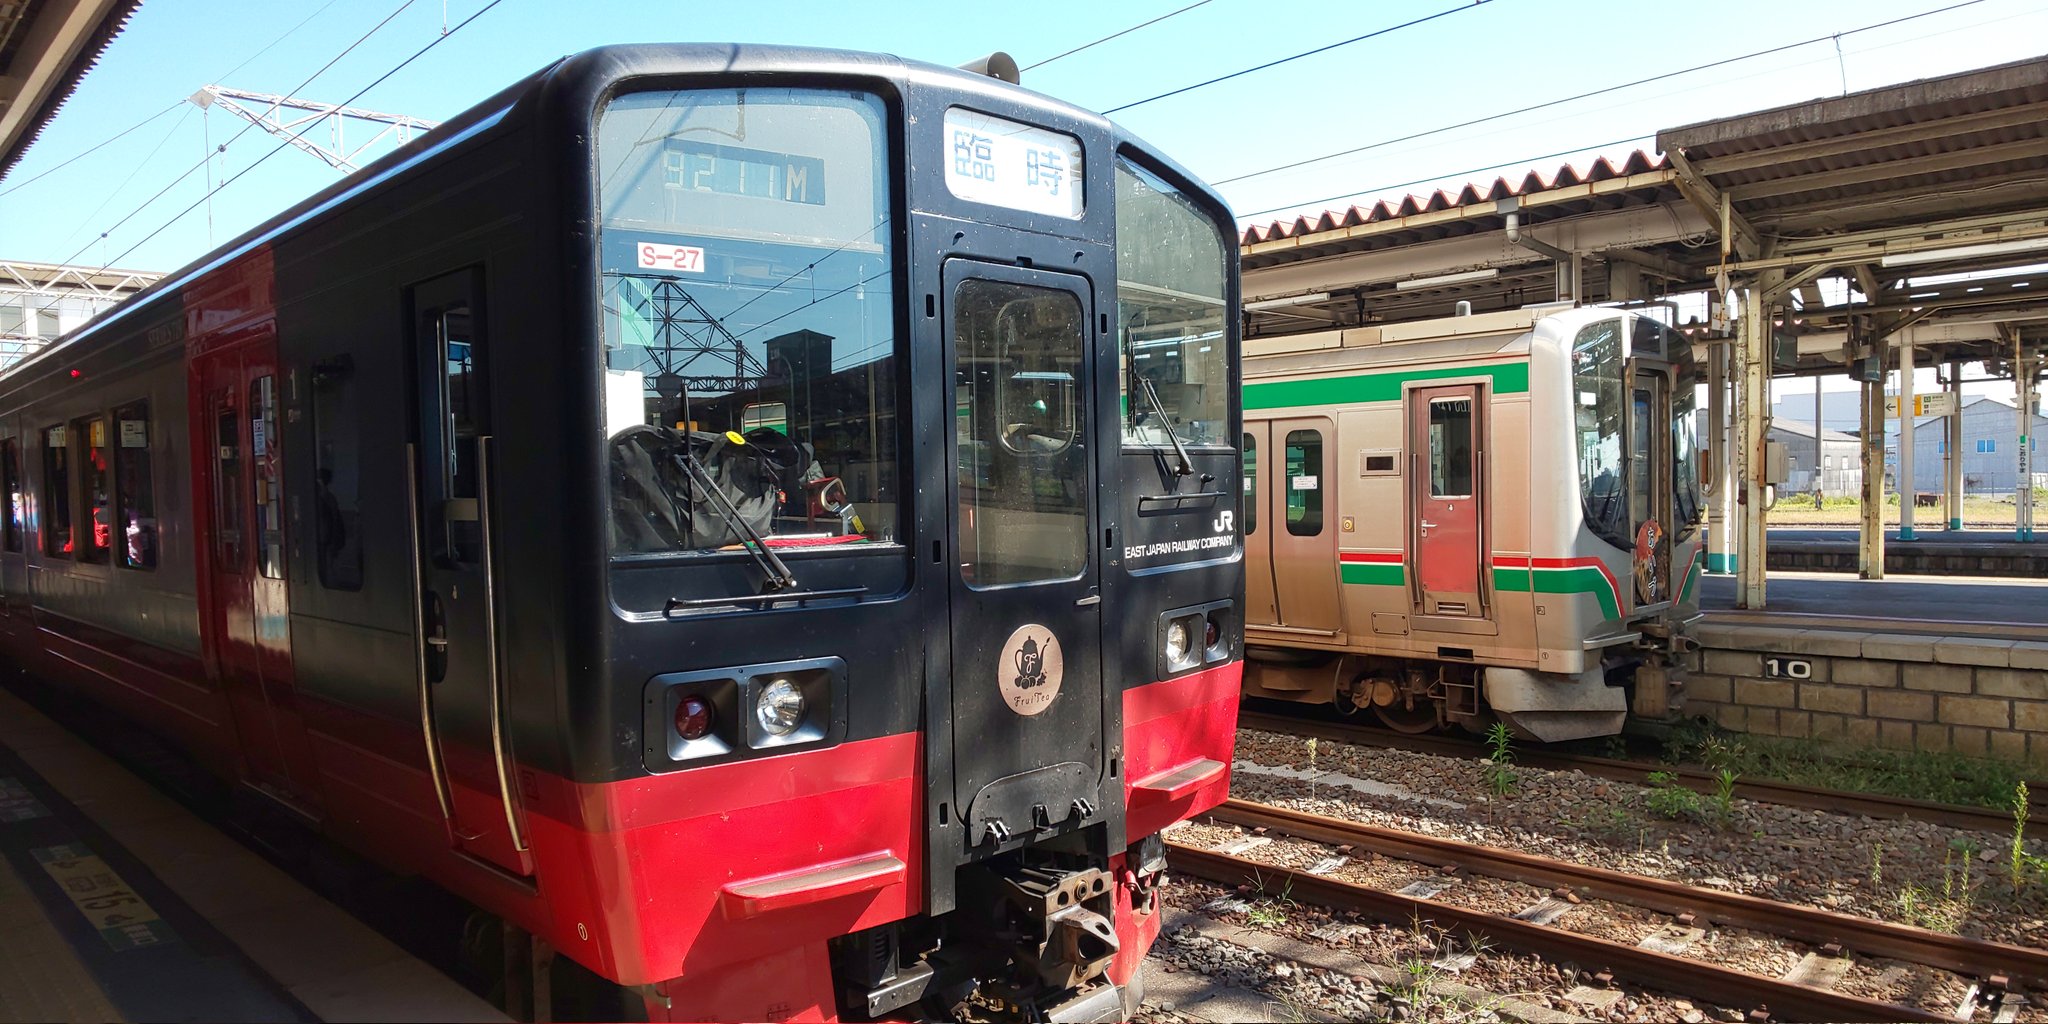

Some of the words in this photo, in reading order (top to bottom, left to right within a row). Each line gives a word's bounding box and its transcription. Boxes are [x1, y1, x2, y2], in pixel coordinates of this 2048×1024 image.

[643, 245, 699, 270] S-27
[1214, 510, 1233, 532] JR
[1125, 545, 1146, 559] EAST
[1146, 542, 1171, 556] JAPAN
[1172, 539, 1201, 553] RAILWAY
[1201, 535, 1233, 549] COMPANY
[1766, 659, 1811, 679] 10
[1013, 692, 1050, 707] FruiTea
